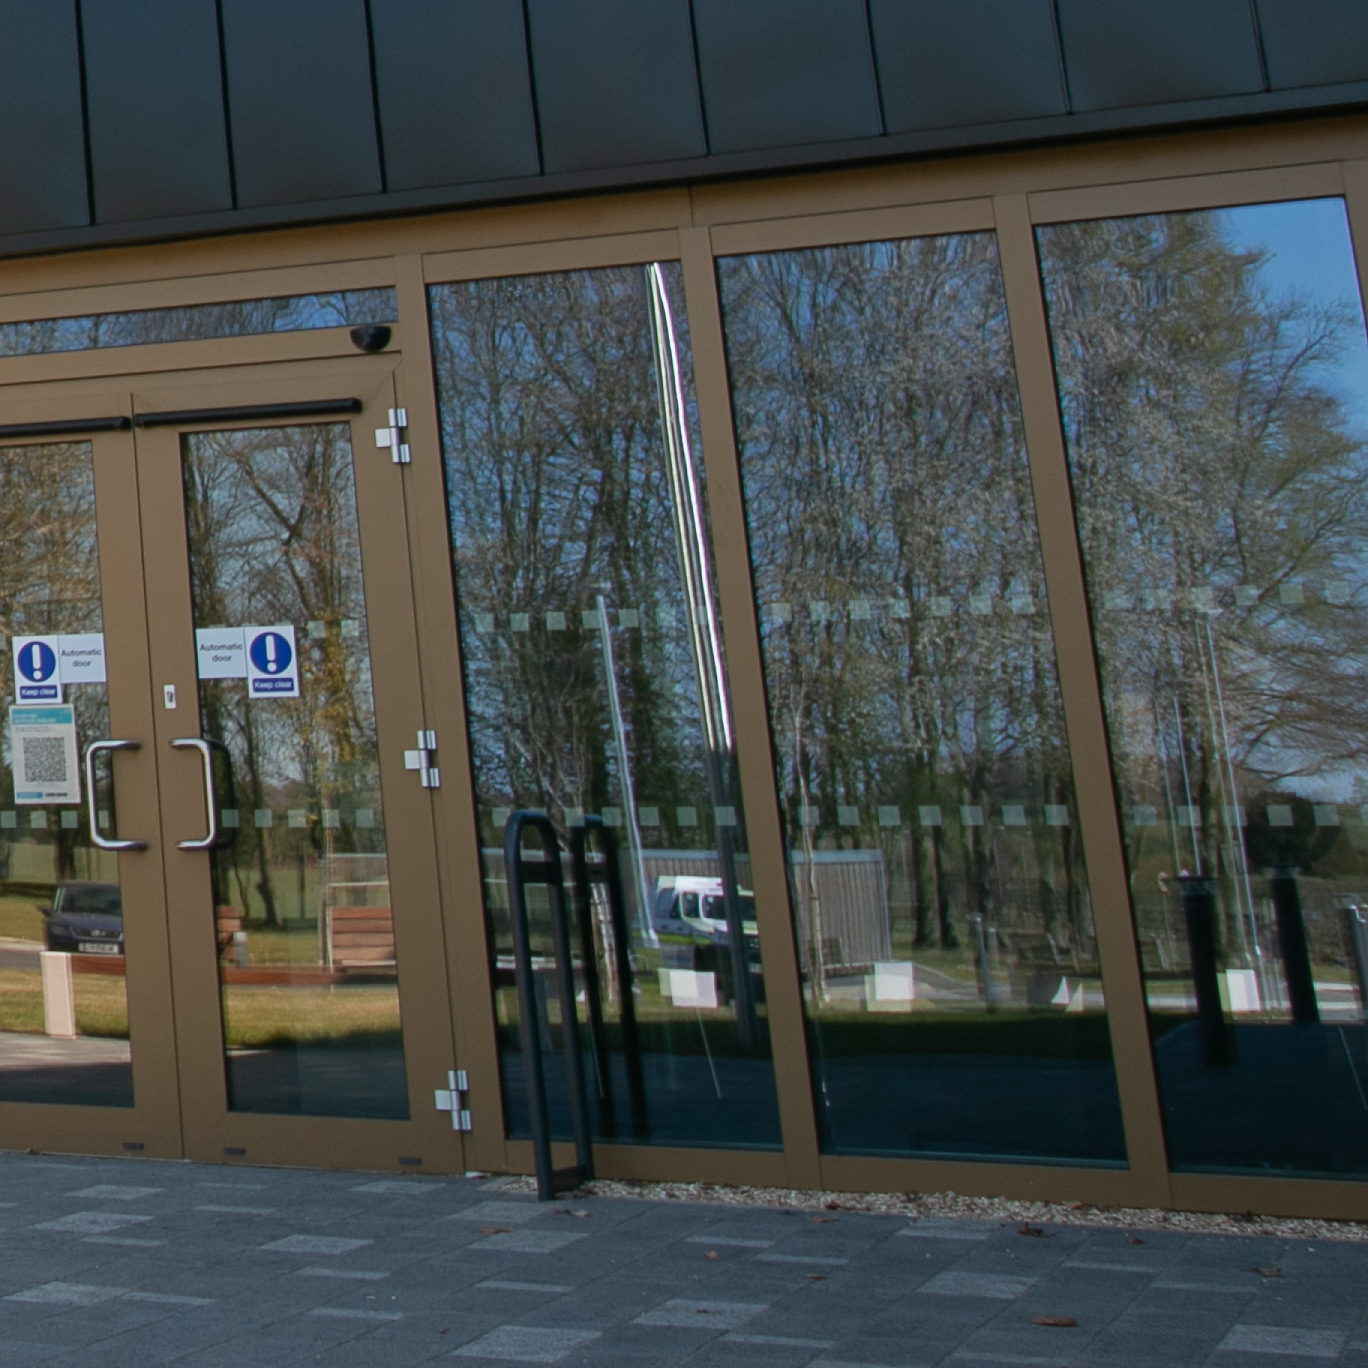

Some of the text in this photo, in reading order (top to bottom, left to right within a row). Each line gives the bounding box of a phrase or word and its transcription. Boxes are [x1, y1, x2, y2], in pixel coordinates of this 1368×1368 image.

[199, 643, 243, 651] Automatic
[61, 648, 102, 657] Automatic
[212, 654, 232, 662] door
[254, 681, 273, 689] Keep
